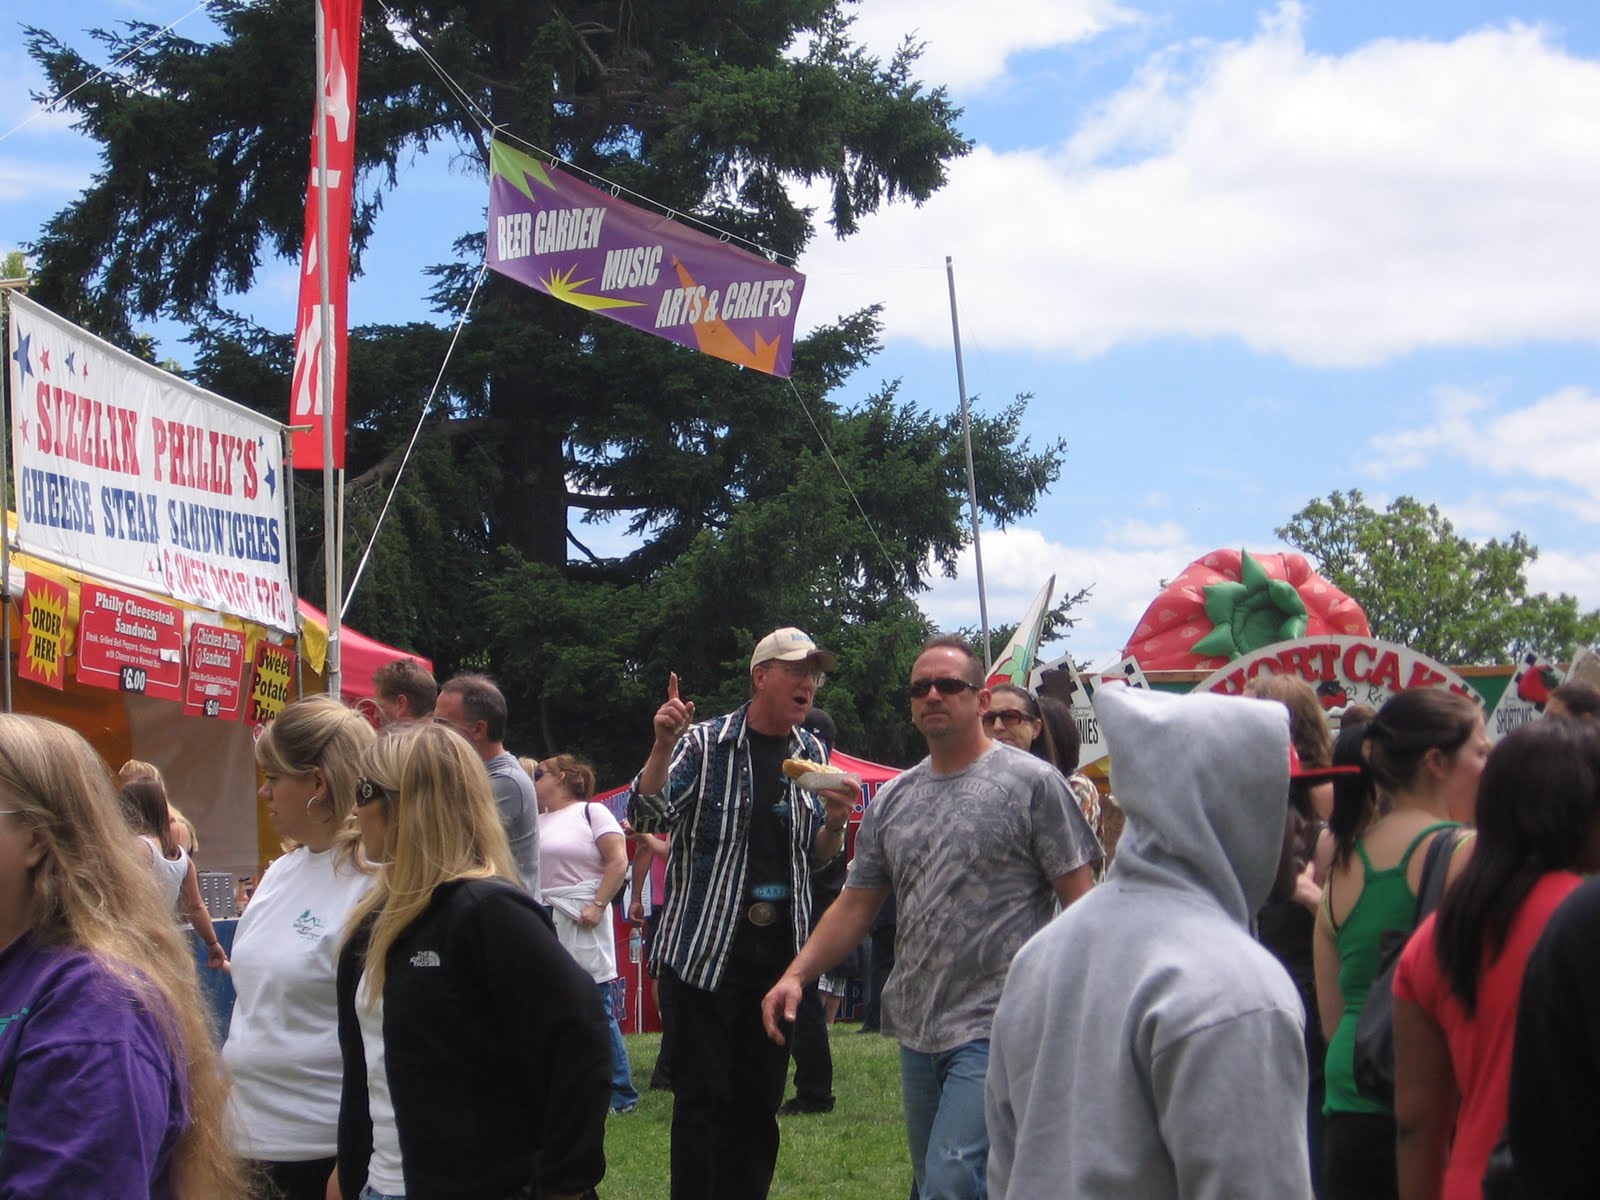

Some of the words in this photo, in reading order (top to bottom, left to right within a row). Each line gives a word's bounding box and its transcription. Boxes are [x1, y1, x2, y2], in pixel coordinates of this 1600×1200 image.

[497, 212, 532, 261] BEER
[534, 207, 607, 255] GARDEN
[600, 245, 663, 291] MUSIC
[655, 284, 705, 328] ARTS
[704, 290, 720, 322] &
[721, 278, 796, 321] CRAFTS
[36, 380, 140, 475] SIZZLIN
[152, 416, 258, 500] PHILLY'S
[22, 465, 96, 535] CHEESE
[101, 484, 160, 544] STEAK
[167, 498, 281, 564] SANDWICHES
[32, 606, 61, 638] ORDER
[95, 591, 124, 616] Philly
[125, 599, 175, 626] Cheesesteak
[114, 617, 157, 642] Sandwich
[197, 627, 222, 648] Chicken
[222, 632, 242, 655] Philly
[34, 634, 57, 664] HERE
[201, 647, 231, 668] Sandwich
[259, 646, 290, 677] Sweet
[123, 668, 146, 691] $6.00
[253, 672, 289, 704] Potato
[251, 699, 276, 722] Frie
